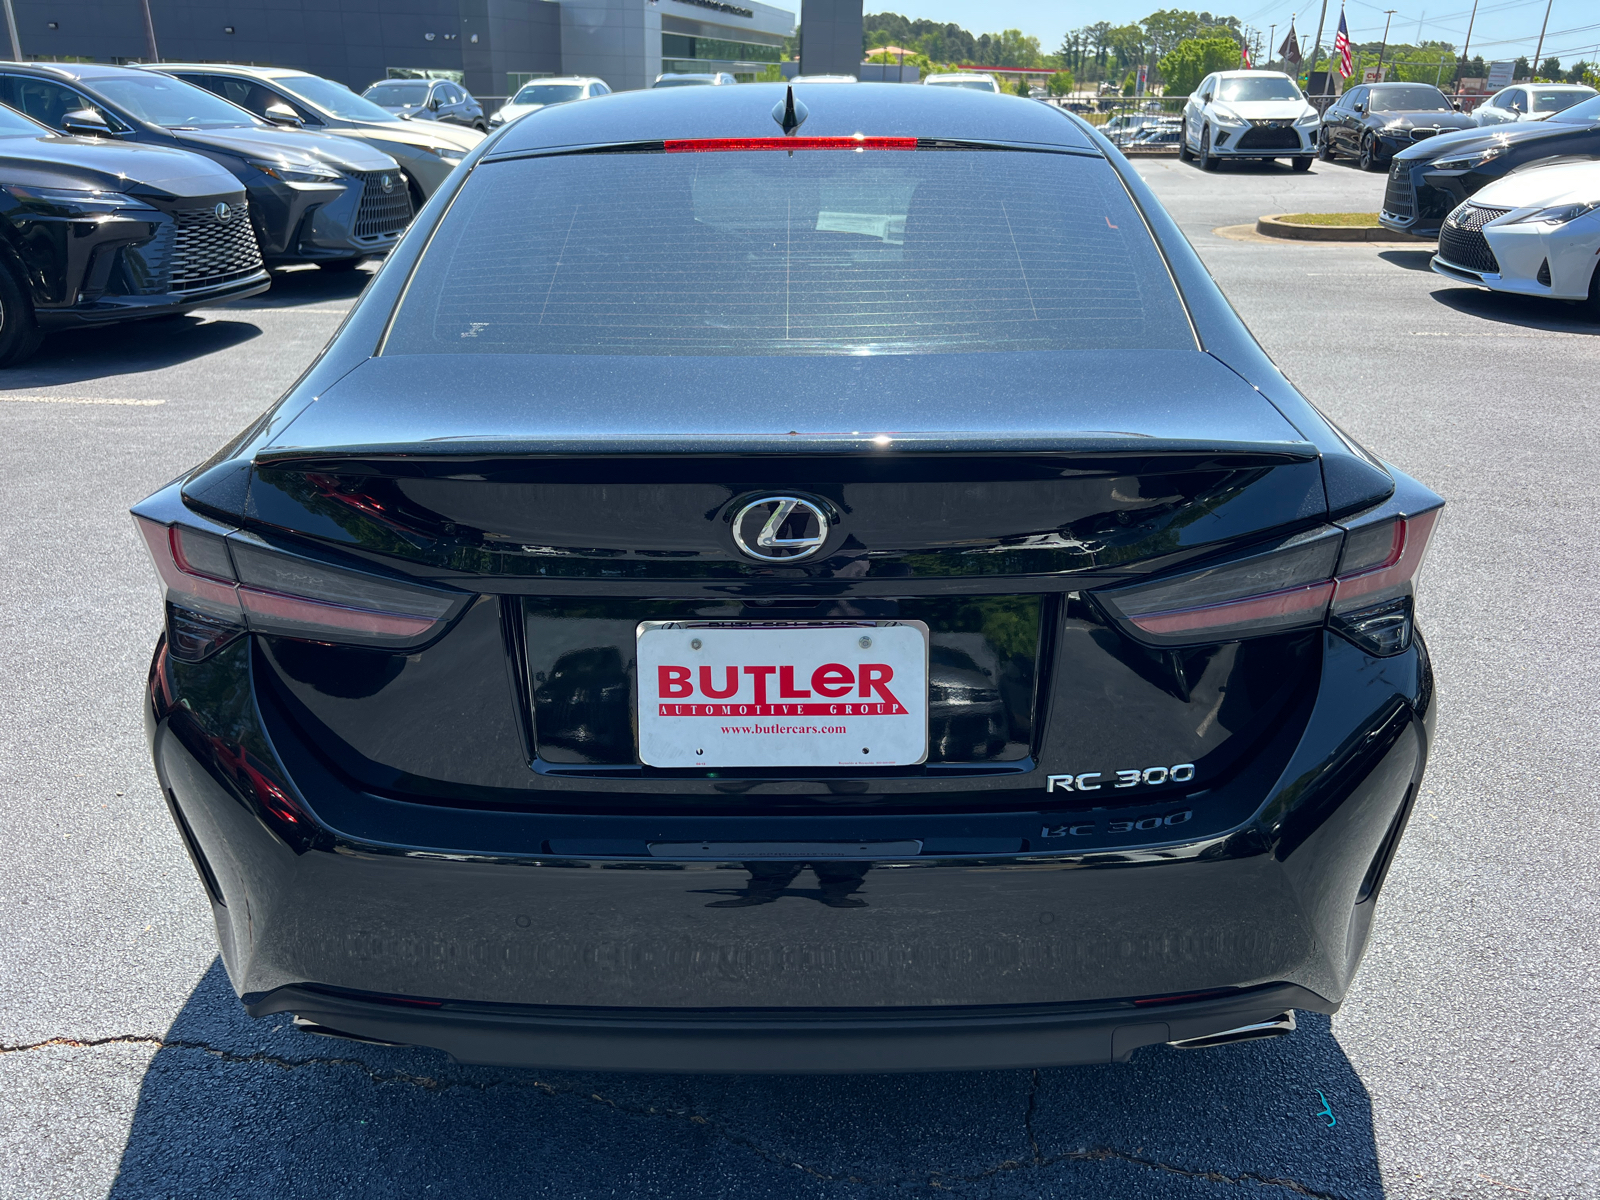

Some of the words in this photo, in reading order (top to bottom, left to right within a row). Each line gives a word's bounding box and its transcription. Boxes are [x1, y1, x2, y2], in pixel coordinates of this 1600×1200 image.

[660, 704, 805, 716] AUTOMOTIVE
[829, 703, 899, 715] GROUP
[720, 723, 847, 735] www.butlercars.com
[1046, 772, 1102, 793] RC
[1114, 763, 1195, 788] 300
